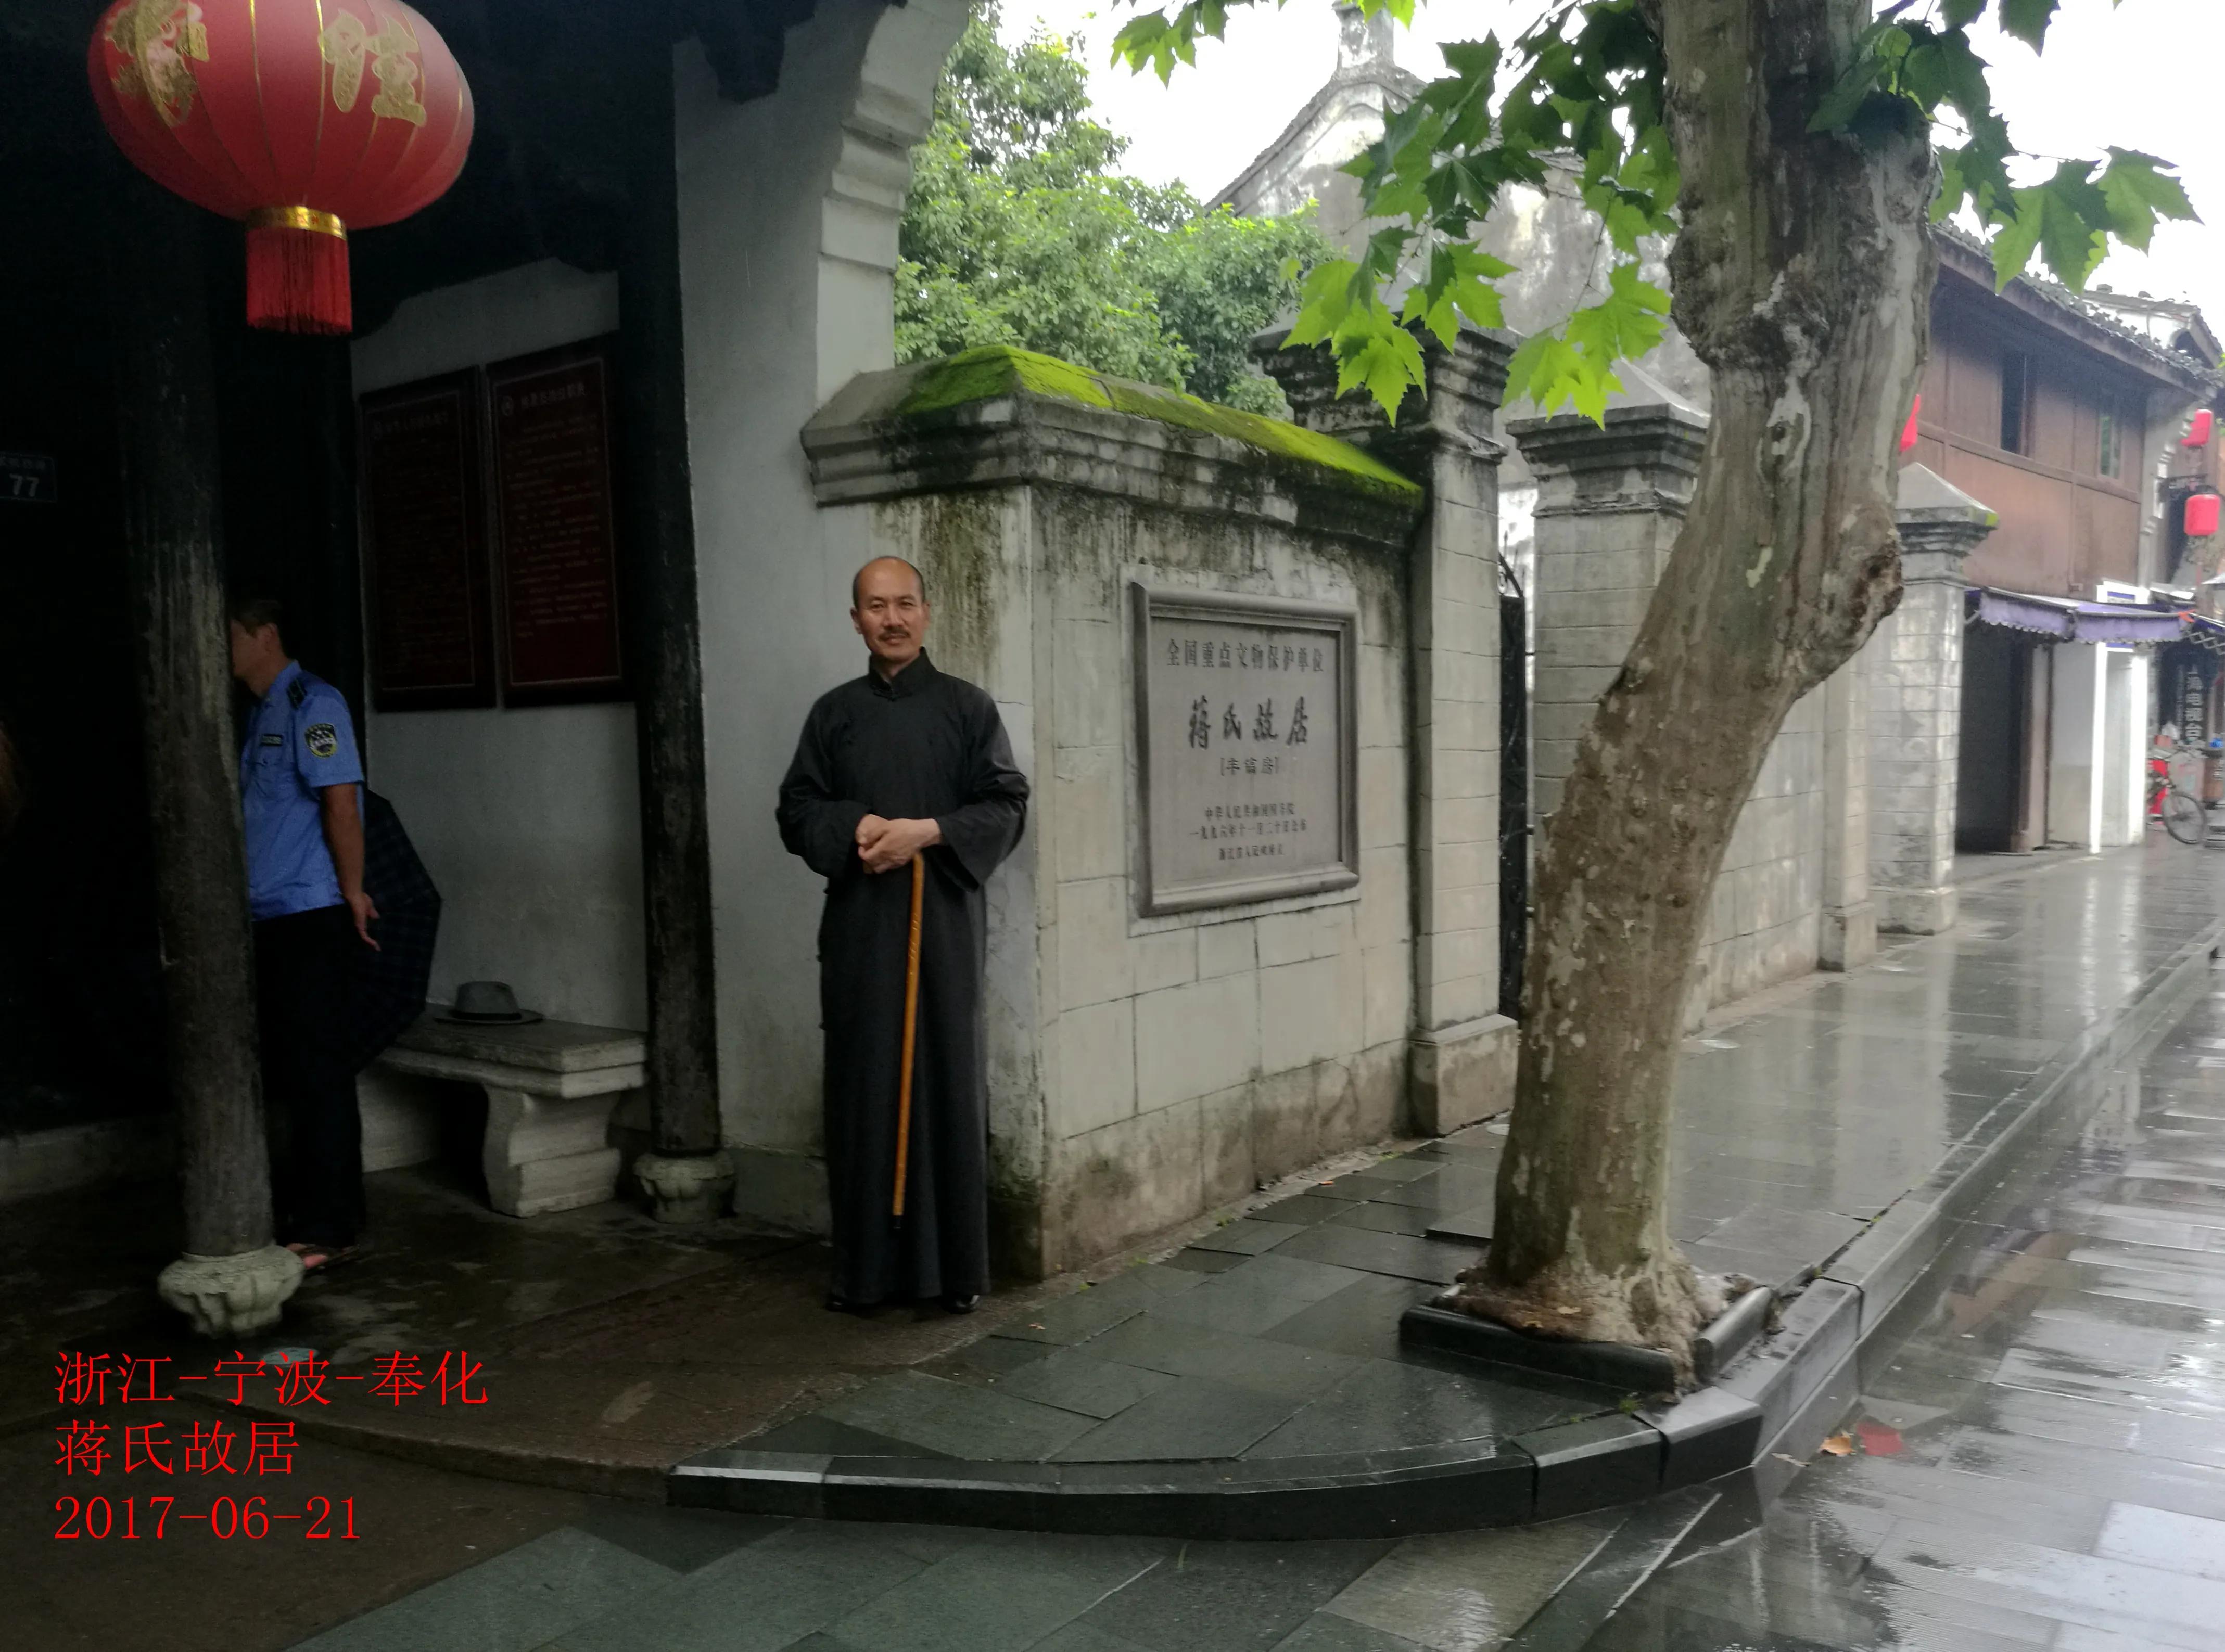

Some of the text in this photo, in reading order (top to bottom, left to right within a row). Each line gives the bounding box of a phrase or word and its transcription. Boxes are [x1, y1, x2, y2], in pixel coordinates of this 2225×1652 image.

[9, 473, 40, 497] 77
[1166, 638, 1324, 672] 全国重点文物保护单位
